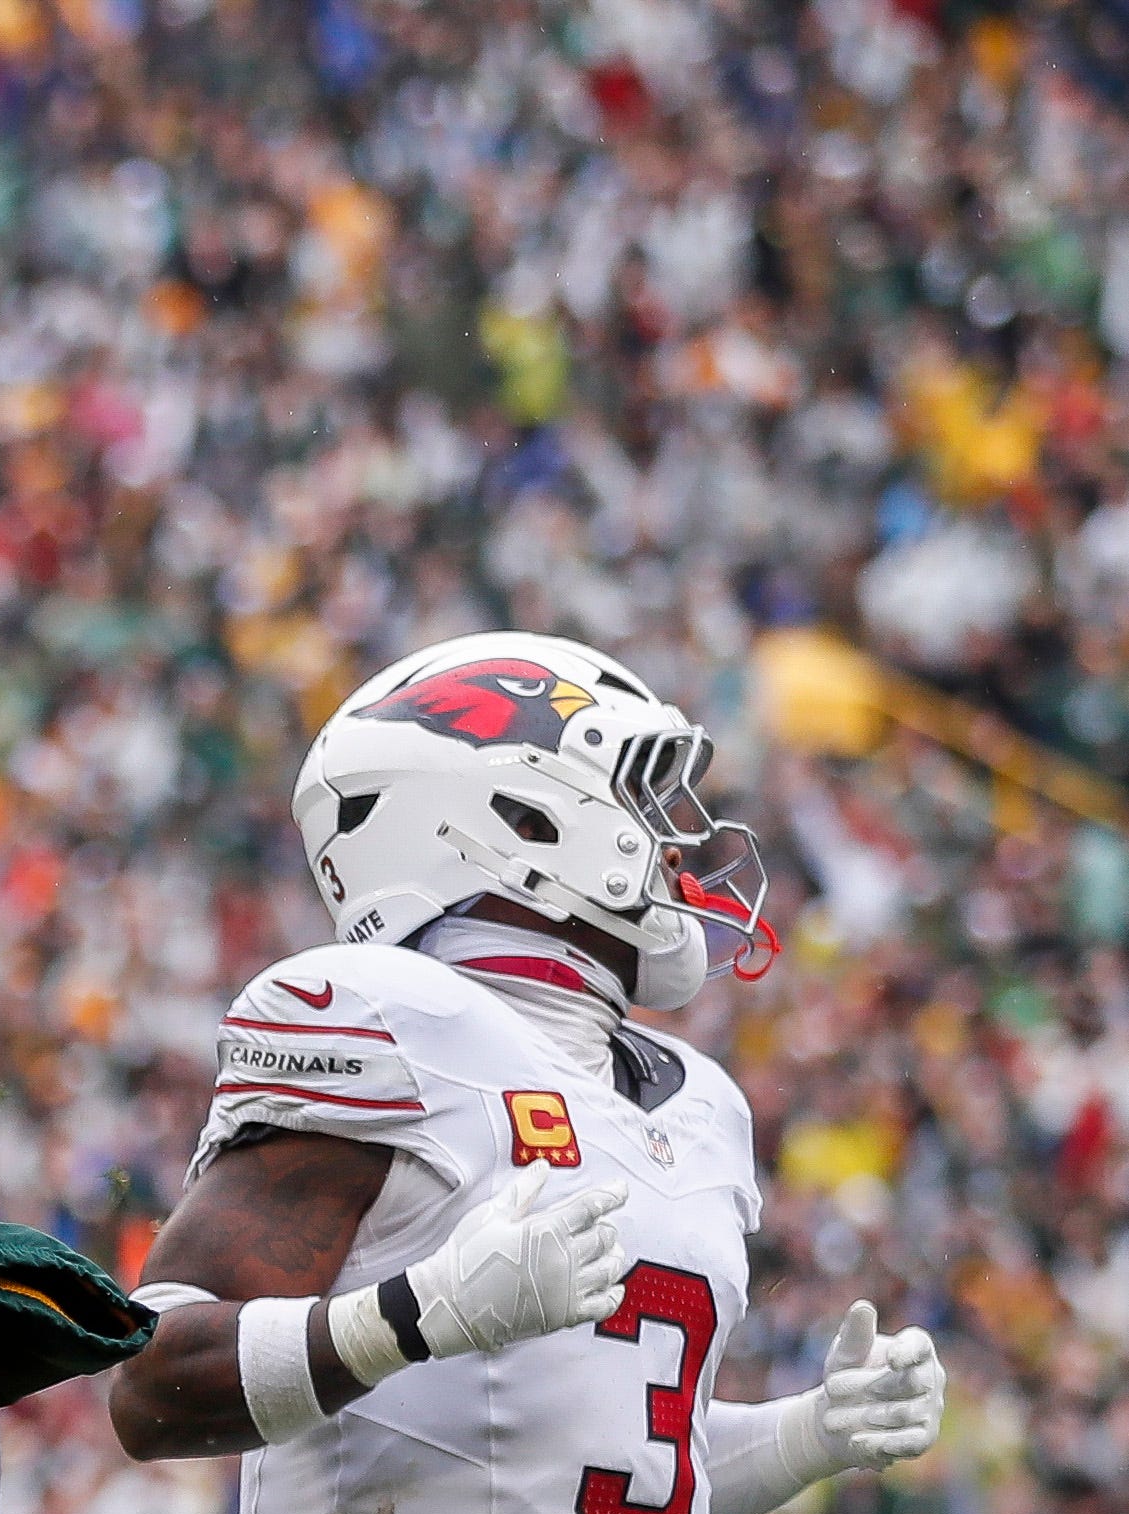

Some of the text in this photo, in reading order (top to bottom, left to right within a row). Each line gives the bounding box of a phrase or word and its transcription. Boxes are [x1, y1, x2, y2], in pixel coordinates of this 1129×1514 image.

[320, 855, 346, 904] 3
[230, 1048, 364, 1075] CARDINALS
[511, 1092, 572, 1148] C
